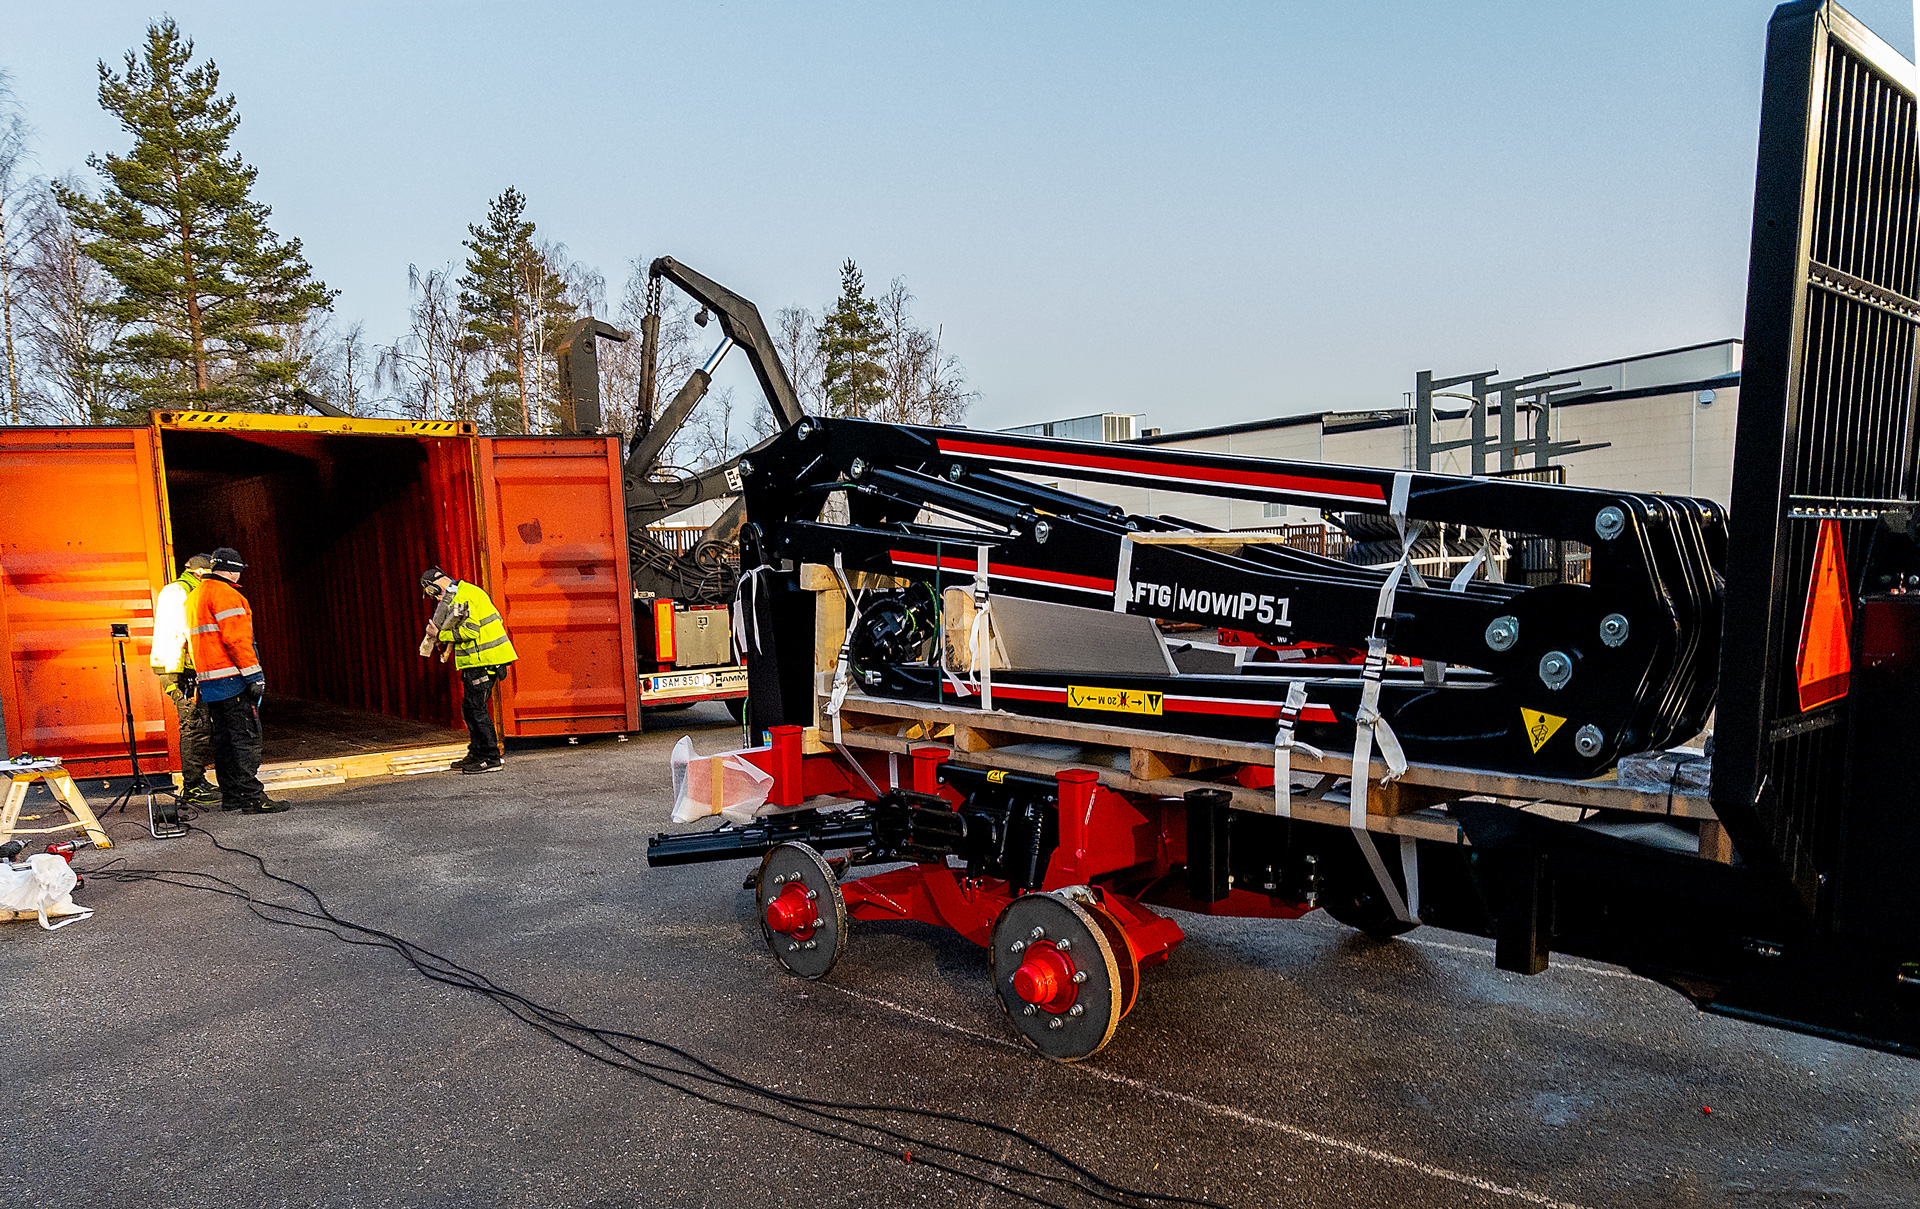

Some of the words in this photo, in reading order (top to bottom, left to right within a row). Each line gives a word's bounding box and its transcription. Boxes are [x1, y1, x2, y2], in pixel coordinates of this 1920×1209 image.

[1135, 582, 1171, 607] FTG
[662, 677, 680, 688] SAM
[715, 674, 748, 683] HAMM
